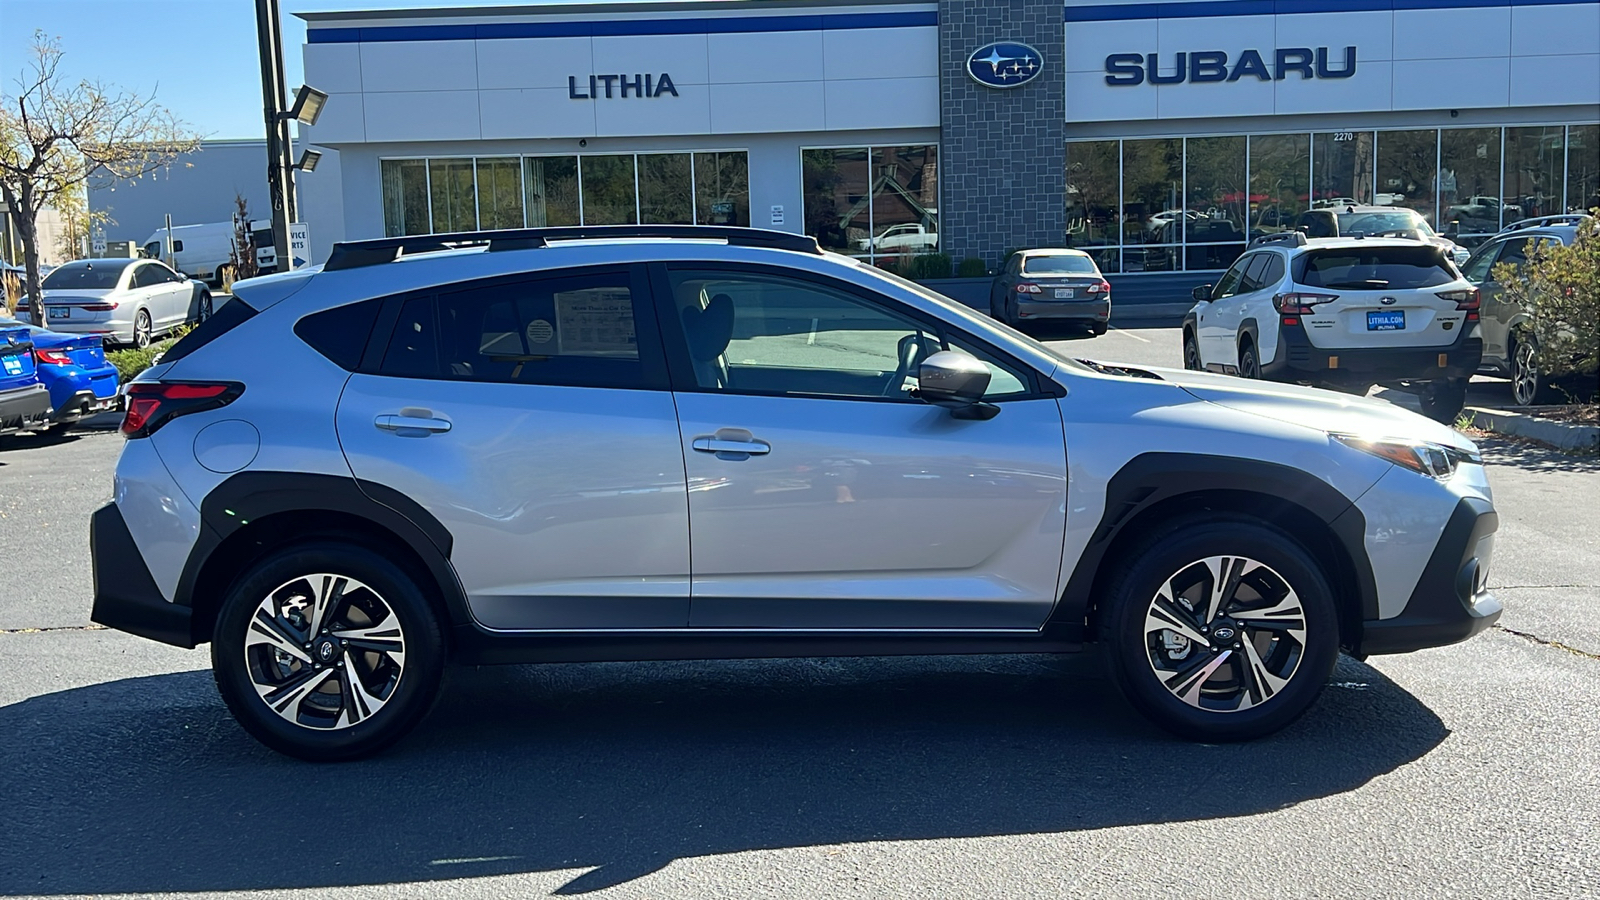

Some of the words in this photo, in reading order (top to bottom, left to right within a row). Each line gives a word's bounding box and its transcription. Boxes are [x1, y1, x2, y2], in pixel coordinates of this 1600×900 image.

[1105, 46, 1357, 86] SUBARU
[568, 73, 679, 99] LITHIA
[1334, 132, 1353, 141] 2270
[1368, 316, 1404, 325] LITHIA.COM
